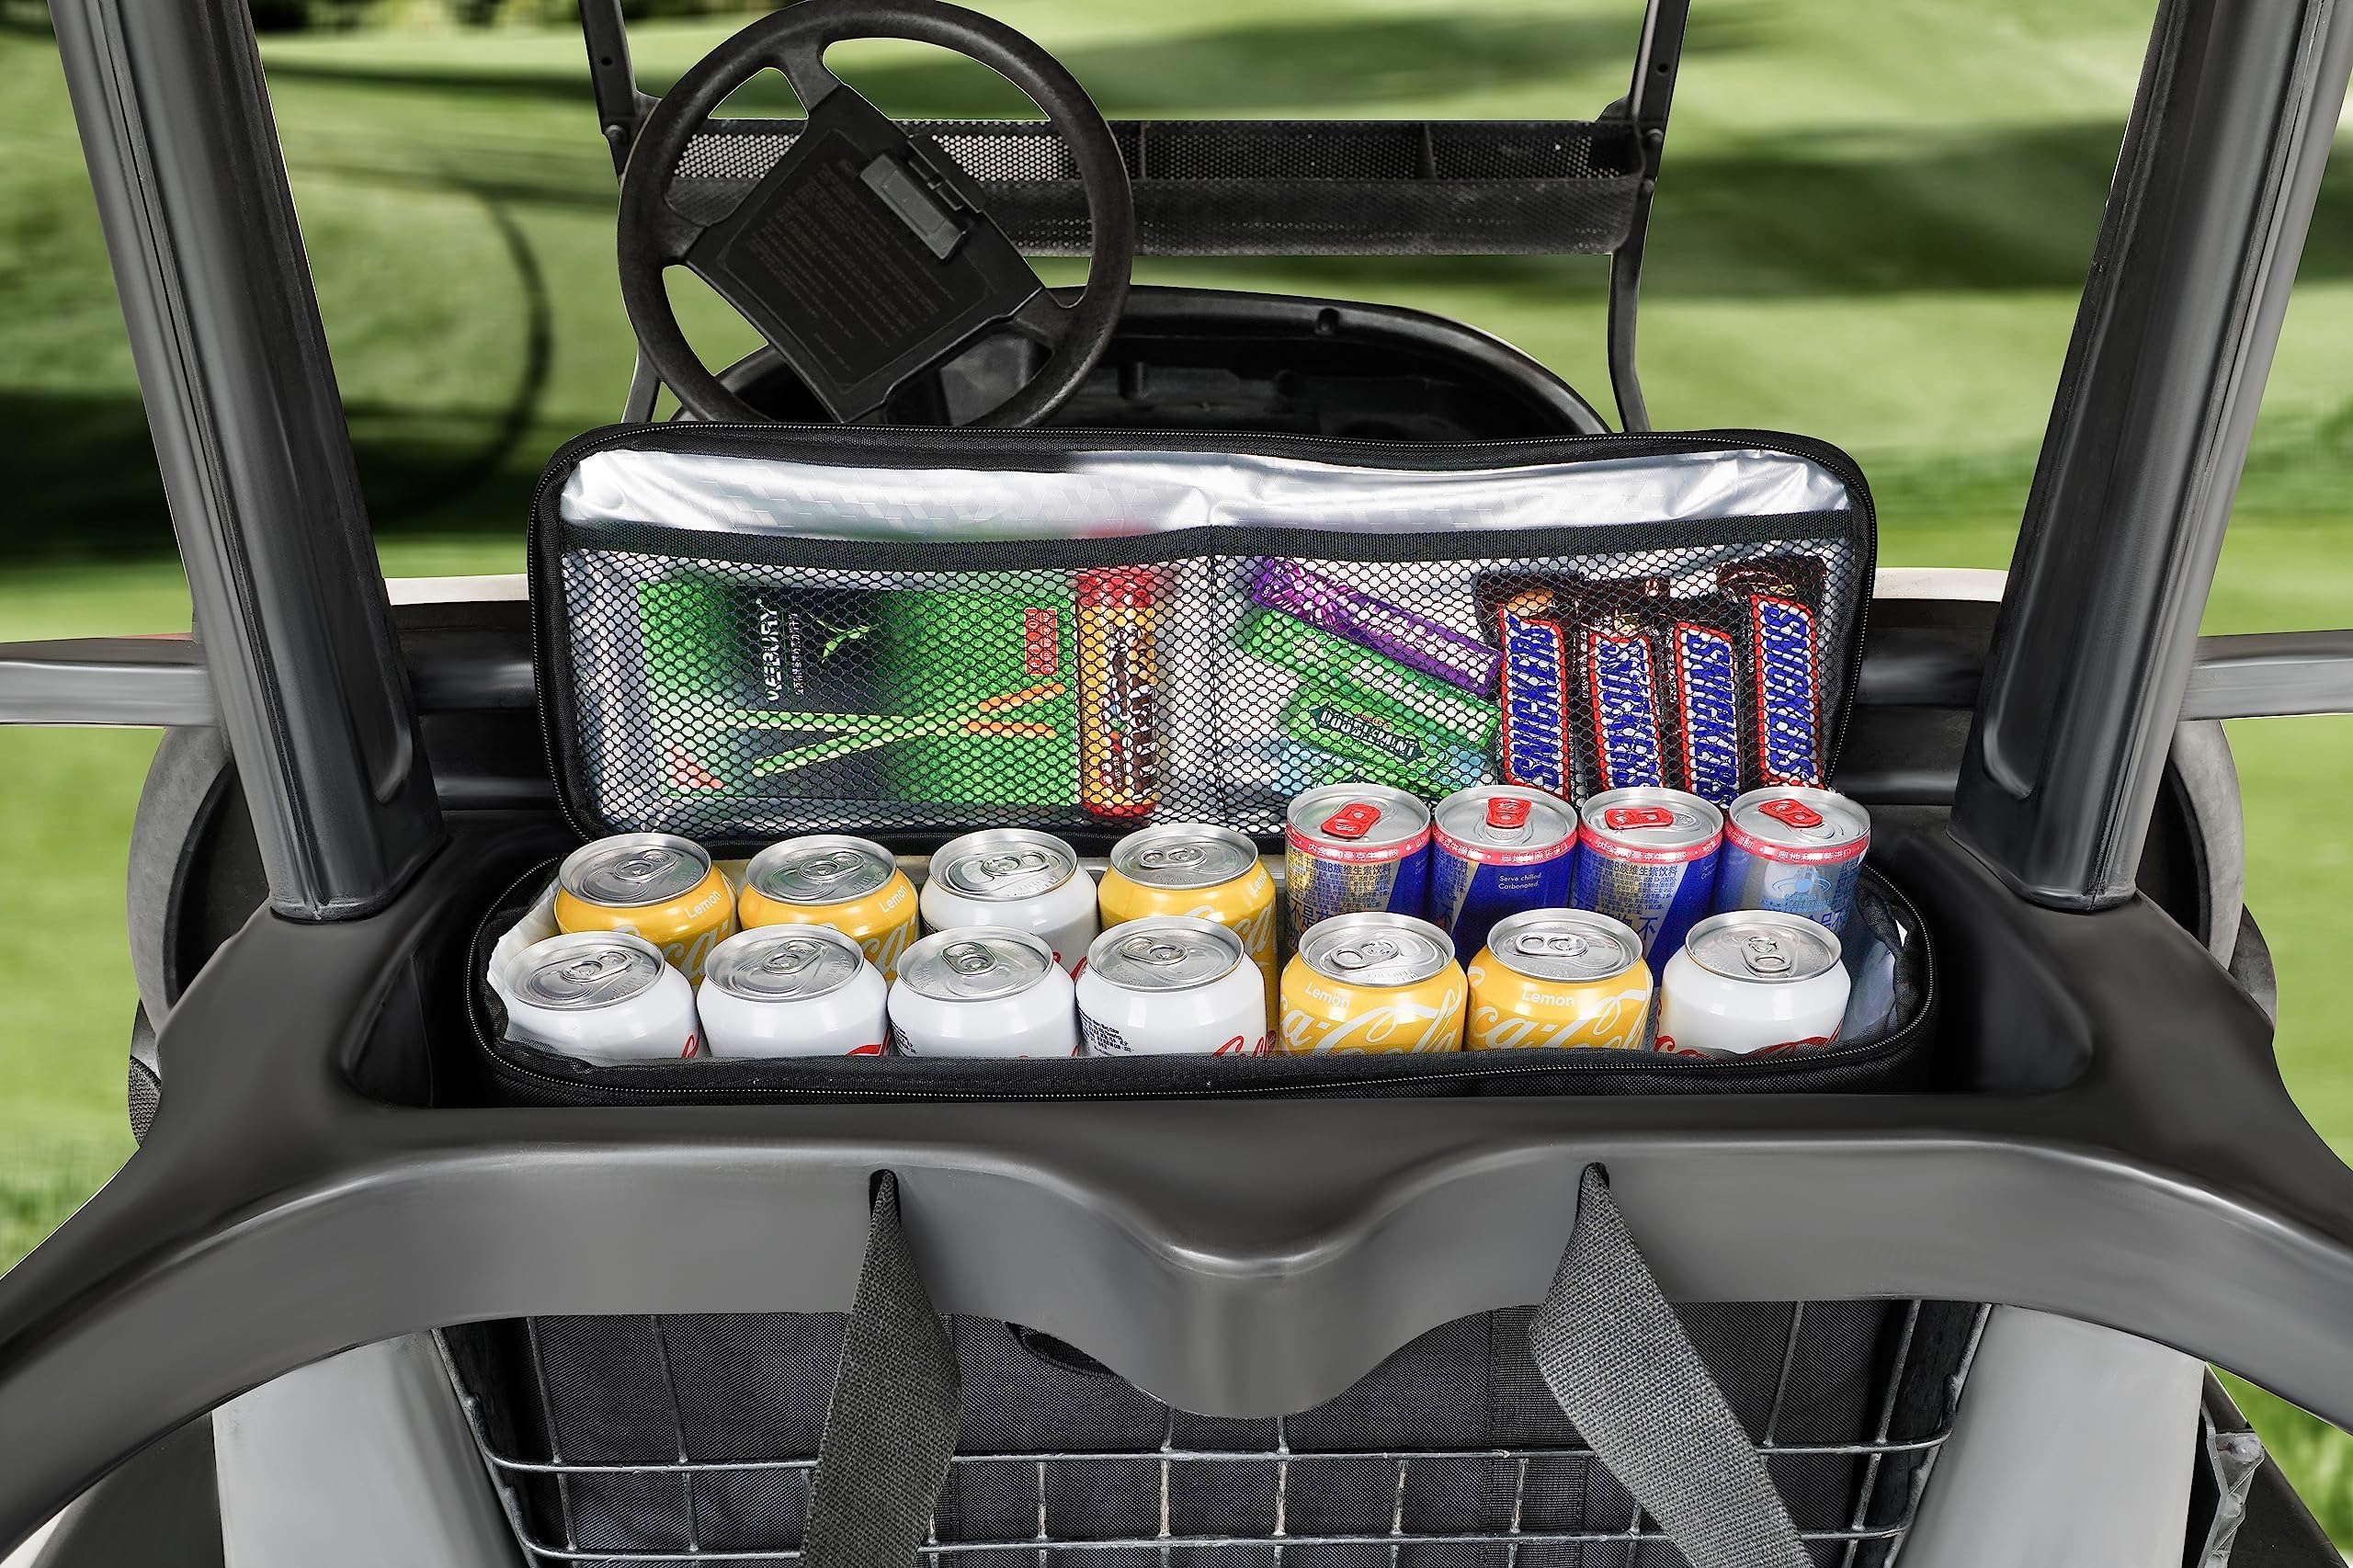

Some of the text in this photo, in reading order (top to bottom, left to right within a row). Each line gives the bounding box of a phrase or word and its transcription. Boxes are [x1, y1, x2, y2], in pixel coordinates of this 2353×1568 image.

[1508, 613, 1558, 788] SNICKERS
[1764, 604, 1813, 781] SNICKERS
[683, 889, 722, 920] Lemon
[879, 885, 907, 913] Lemon
[1304, 981, 1351, 1008] Lemon
[1521, 985, 1575, 1007] Lemon
